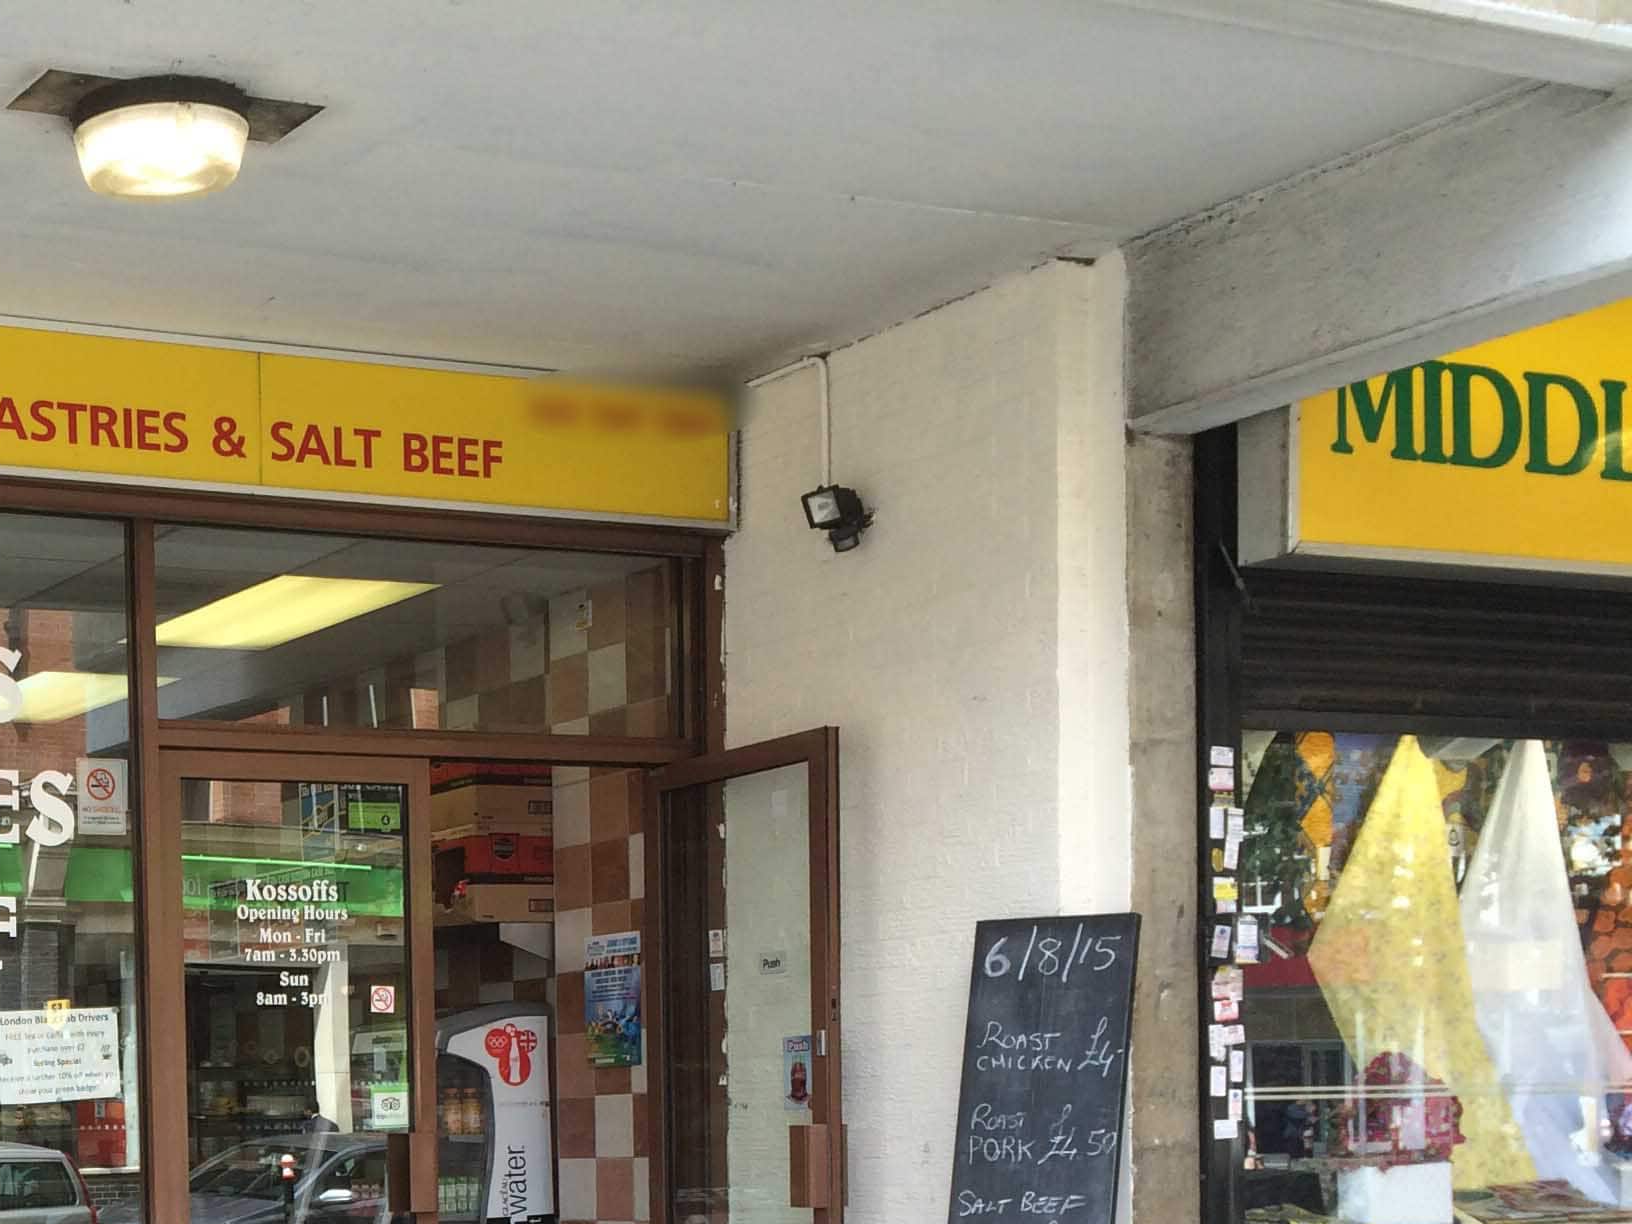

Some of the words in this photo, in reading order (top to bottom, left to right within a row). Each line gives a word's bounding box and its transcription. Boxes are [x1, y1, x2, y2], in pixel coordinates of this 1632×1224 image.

[211, 415, 246, 458] &
[270, 421, 382, 470] SALT
[403, 433, 503, 479] BEEF
[245, 879, 339, 902] Kossoffs
[237, 905, 300, 923] Opening
[303, 906, 349, 920] Hours
[259, 928, 292, 943] Mon
[305, 928, 326, 943] Fri
[244, 948, 276, 962] 7am
[289, 948, 341, 966] 3.30pm
[984, 922, 1122, 983] 6/8/15
[762, 958, 781, 969] Push
[279, 971, 309, 987] Sun
[256, 991, 288, 1006] 8am
[0, 1015, 33, 1026] London
[78, 1012, 109, 1023] Drivers
[976, 1021, 1062, 1051] ROAST
[976, 1053, 1072, 1073] CHICKEN
[971, 1103, 1025, 1131] ROAST
[969, 1135, 1036, 1165] PORK
[958, 1190, 1013, 1217] SALT
[1020, 1191, 1088, 1215] BEEF
